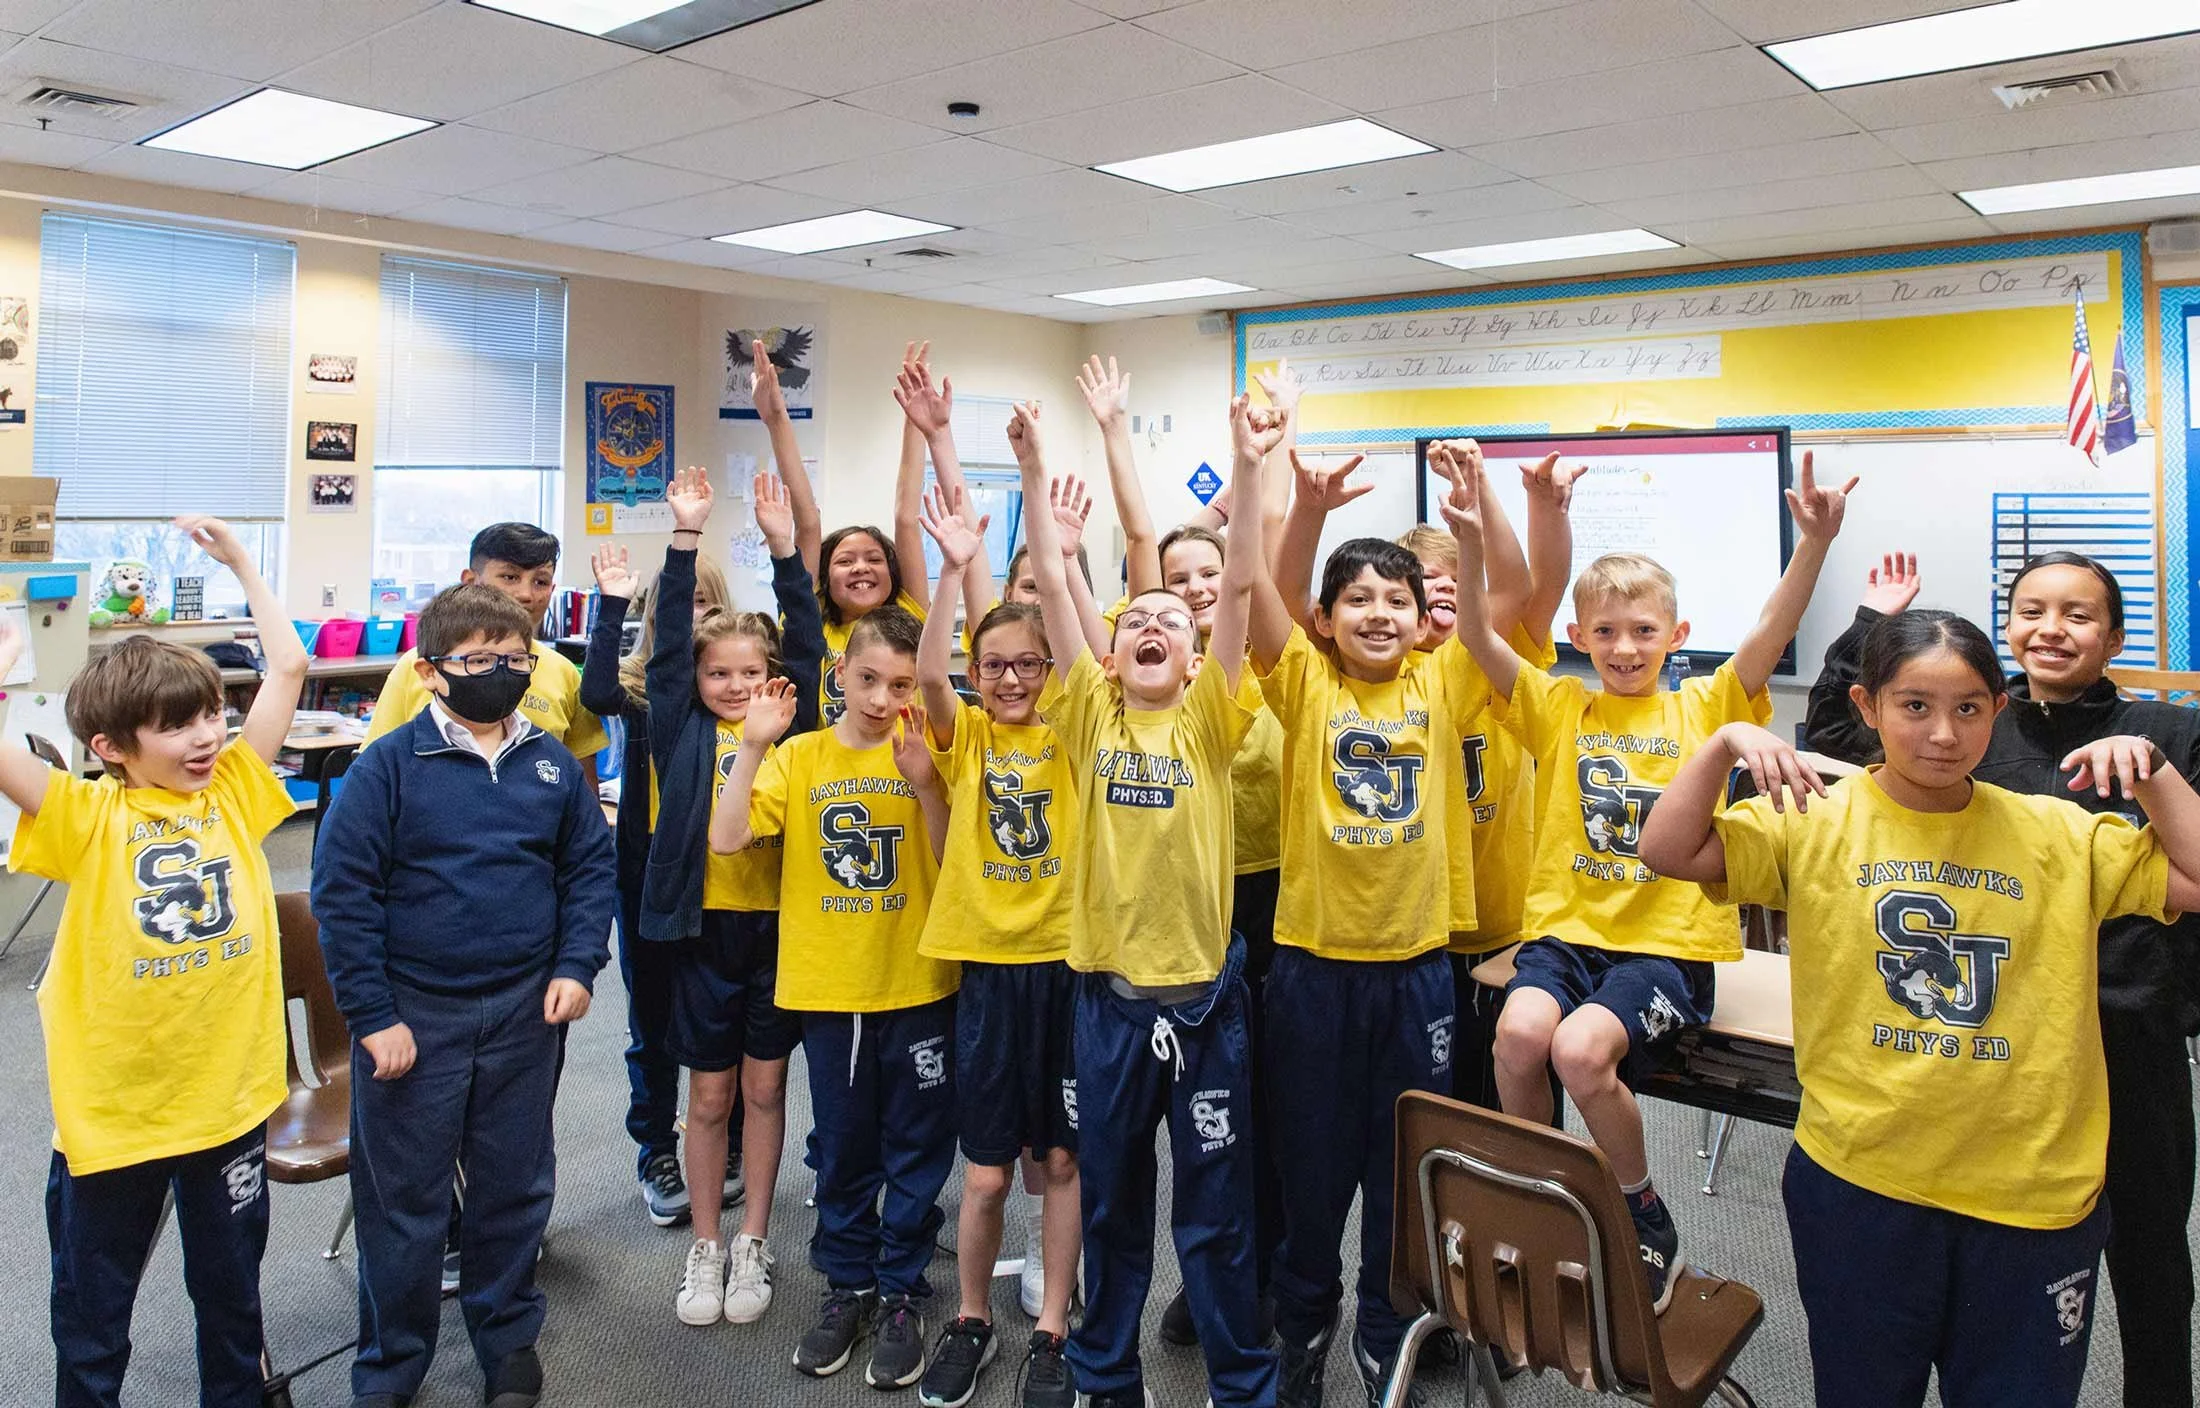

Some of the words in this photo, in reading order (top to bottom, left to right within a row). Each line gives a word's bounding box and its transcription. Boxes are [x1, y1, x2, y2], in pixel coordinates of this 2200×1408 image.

[1252, 332, 1281, 349] Aa
[1290, 328, 1319, 345] Bb
[1327, 326, 1351, 343] Cc
[1404, 320, 1434, 338] Ee
[1979, 269, 2020, 293] Oo
[1112, 786, 1147, 804] PHYS
[820, 801, 905, 891] SJ
[1331, 826, 1393, 845] PHYS
[1402, 821, 1425, 844] ED
[982, 861, 1031, 882] PHYS
[1039, 857, 1062, 879] ED
[1571, 854, 1625, 881] PHYS
[1857, 860, 2024, 900] JAYHAWKS
[821, 895, 874, 913] PHYS
[882, 894, 907, 911] ED
[133, 948, 210, 979] PHYS
[222, 934, 252, 960] ED
[1875, 889, 2011, 1029] SJ
[1873, 1024, 1961, 1057] PHYS
[1972, 1036, 2011, 1060] ED
[1640, 1244, 1665, 1269] as
